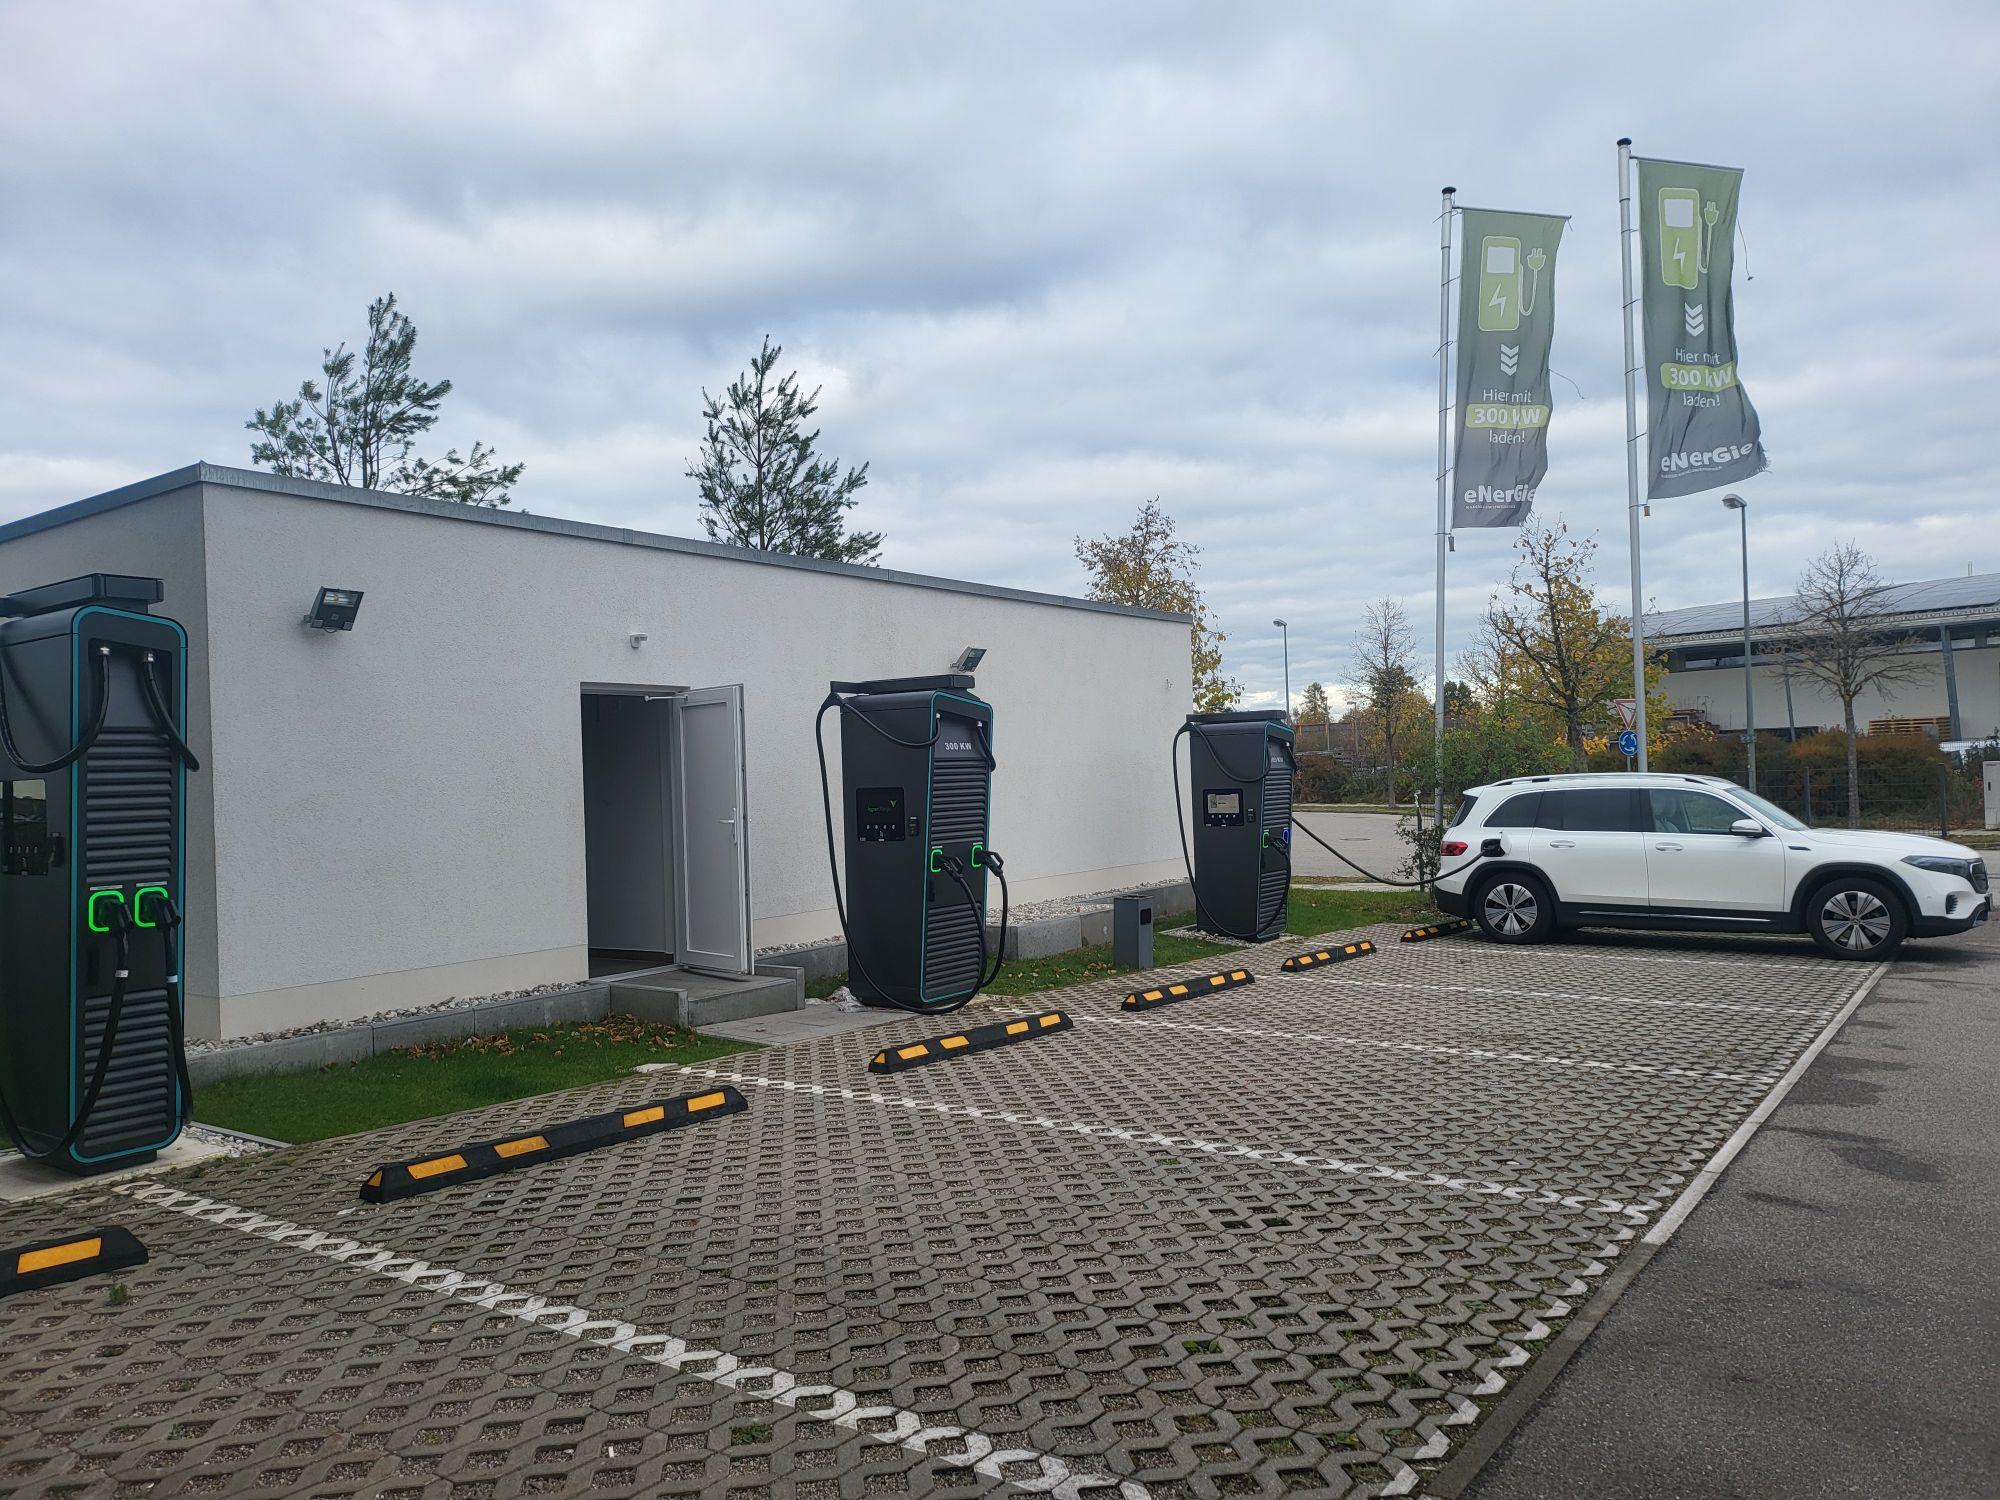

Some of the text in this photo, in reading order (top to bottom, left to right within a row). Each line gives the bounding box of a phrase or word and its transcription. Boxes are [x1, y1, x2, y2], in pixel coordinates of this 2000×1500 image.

[1675, 347, 1721, 364] Hier mit
[1669, 366, 1732, 388] 300 kW
[1483, 389, 1532, 403] Hier mit
[1683, 391, 1721, 408] laden!
[1474, 407, 1541, 426] 300 kW
[1489, 429, 1525, 445] laden!
[1660, 442, 1753, 472] eNerGie
[944, 742, 972, 751] 300 KW
